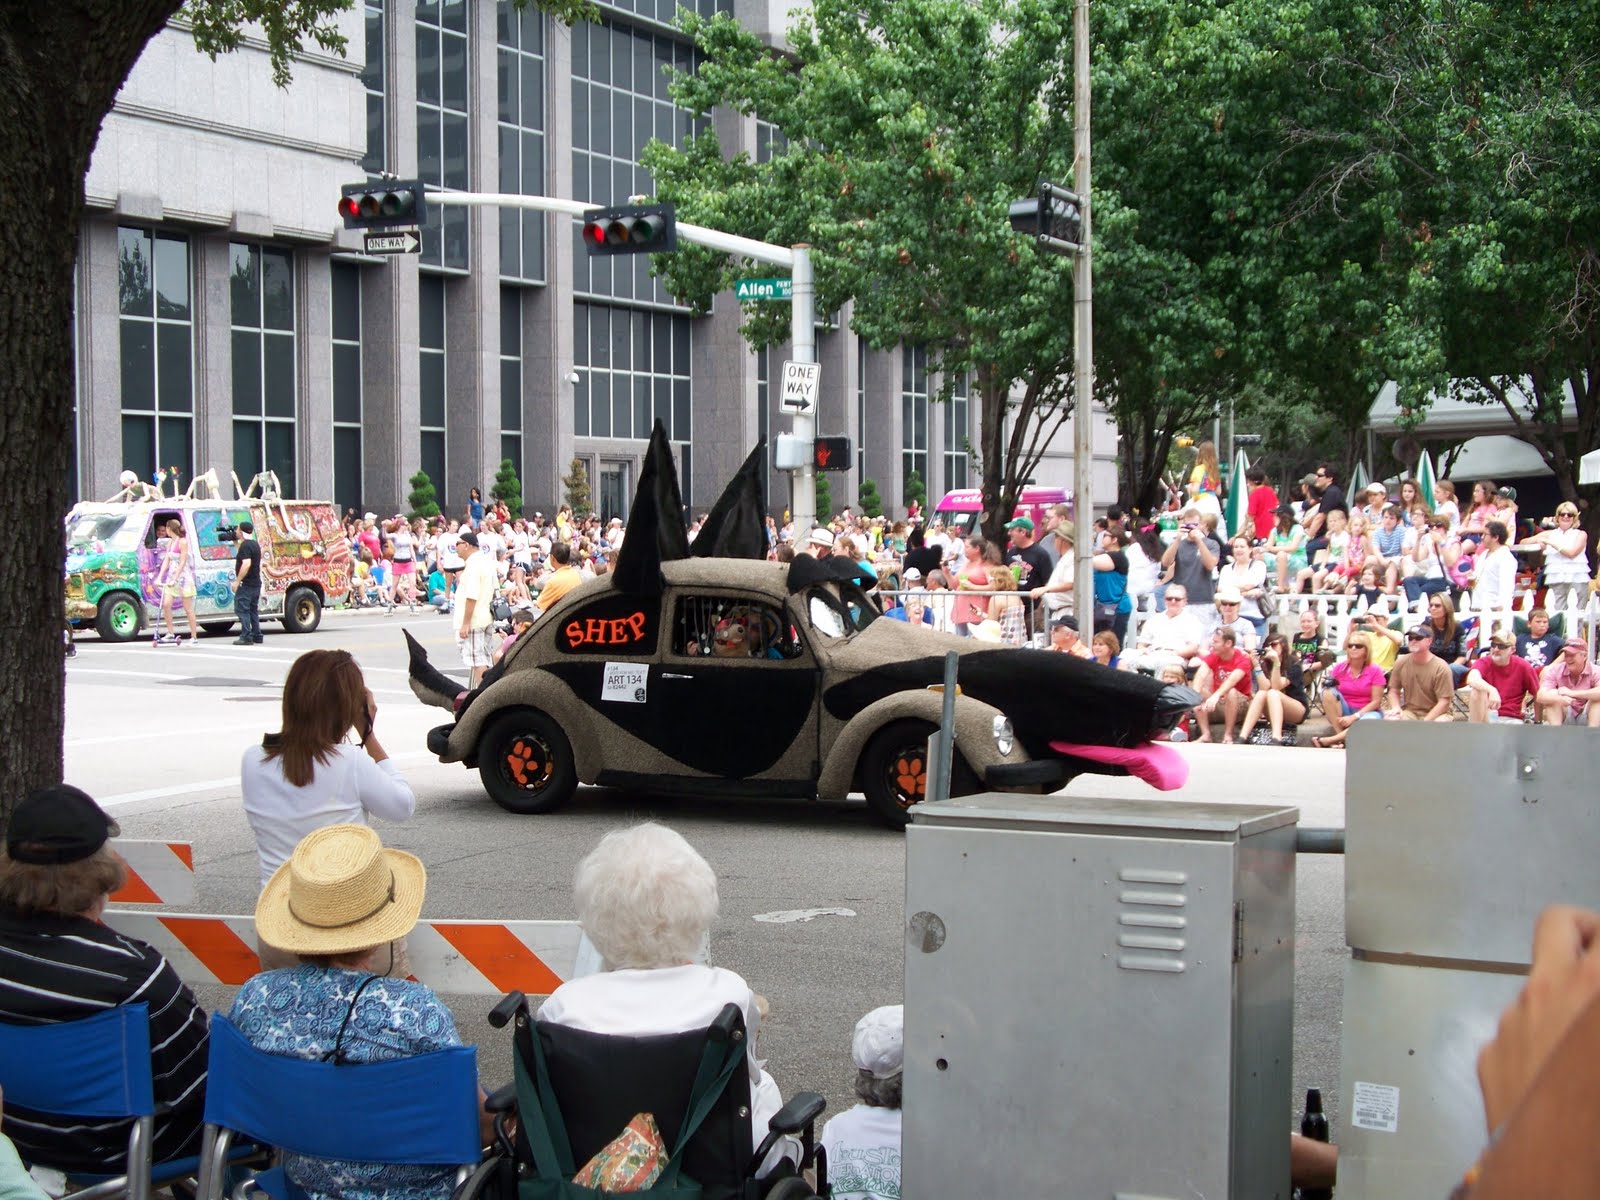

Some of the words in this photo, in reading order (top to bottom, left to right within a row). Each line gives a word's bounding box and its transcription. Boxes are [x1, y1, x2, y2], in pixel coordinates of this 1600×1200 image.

[369, 239, 386, 249] ONE
[388, 238, 406, 247] WAY
[738, 283, 774, 296] Allen
[788, 366, 815, 379] ONE
[787, 381, 813, 395] WAY
[565, 611, 646, 648] SHEP
[608, 675, 625, 685] ART
[627, 674, 642, 685] 134
